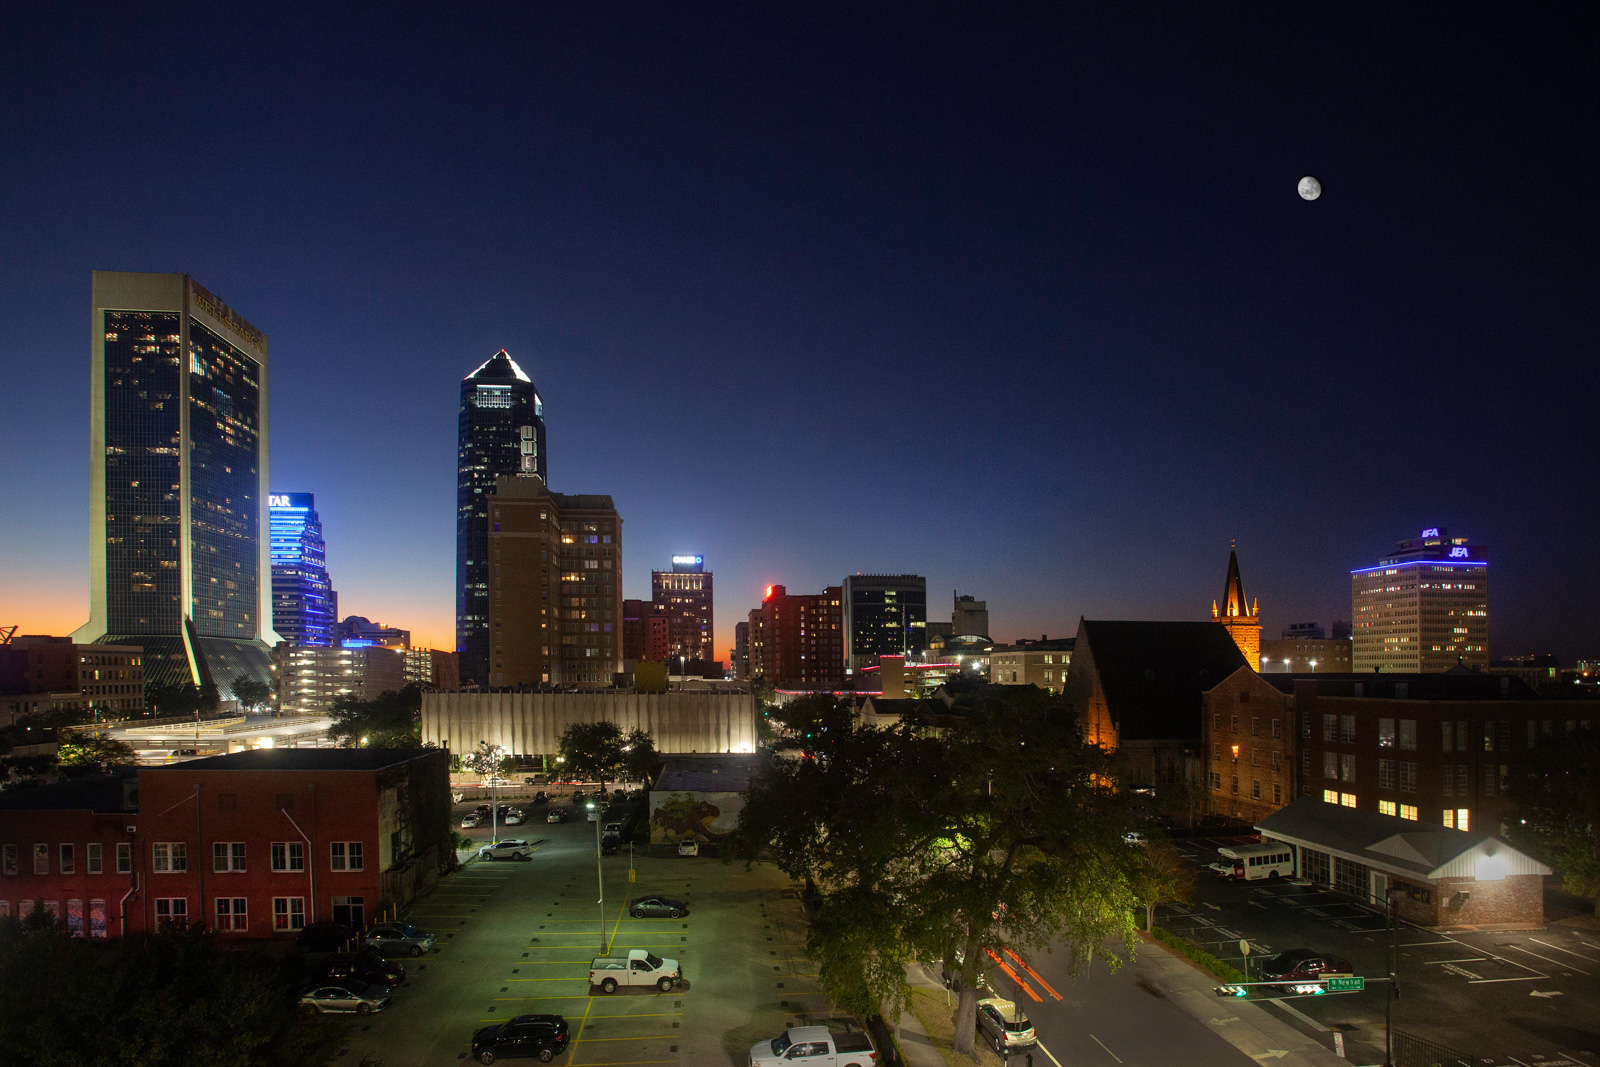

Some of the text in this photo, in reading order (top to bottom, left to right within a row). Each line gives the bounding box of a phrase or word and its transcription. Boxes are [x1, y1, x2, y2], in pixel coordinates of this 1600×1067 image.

[193, 293, 264, 353] WELLS FARGO
[1448, 547, 1468, 557] JEA
